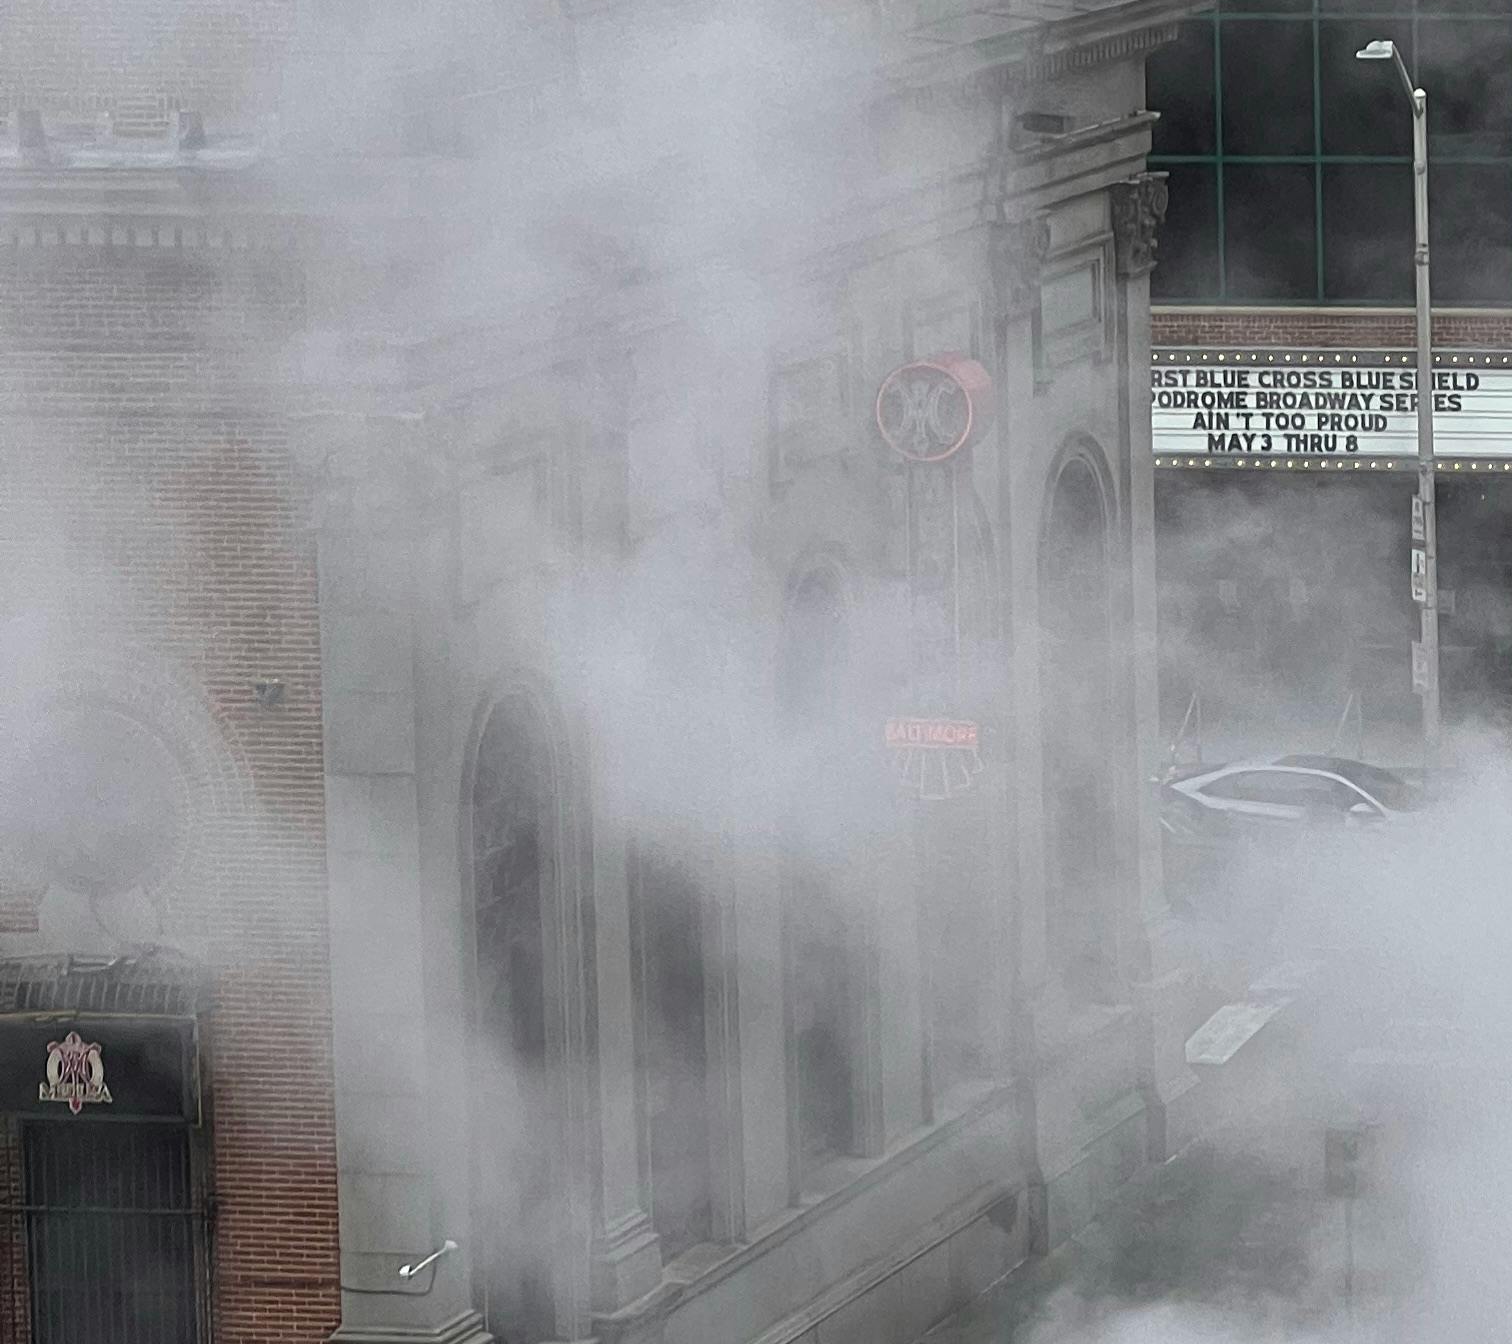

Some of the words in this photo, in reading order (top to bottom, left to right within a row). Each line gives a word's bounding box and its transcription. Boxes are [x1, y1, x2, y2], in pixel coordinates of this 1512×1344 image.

[1195, 370, 1250, 388] BLUE
[1258, 371, 1333, 389] CROSS
[1341, 371, 1396, 390] BLUE
[1400, 372, 1480, 391] SIELD
[1255, 391, 1376, 411] BROADWAY
[1379, 393, 1462, 412] SERES
[1262, 412, 1306, 431] TOO
[1317, 413, 1388, 432] PROUD
[1207, 432, 1257, 453] MAY
[1260, 433, 1273, 452] 3
[1283, 433, 1338, 453] THRU
[1345, 434, 1359, 453] 8
